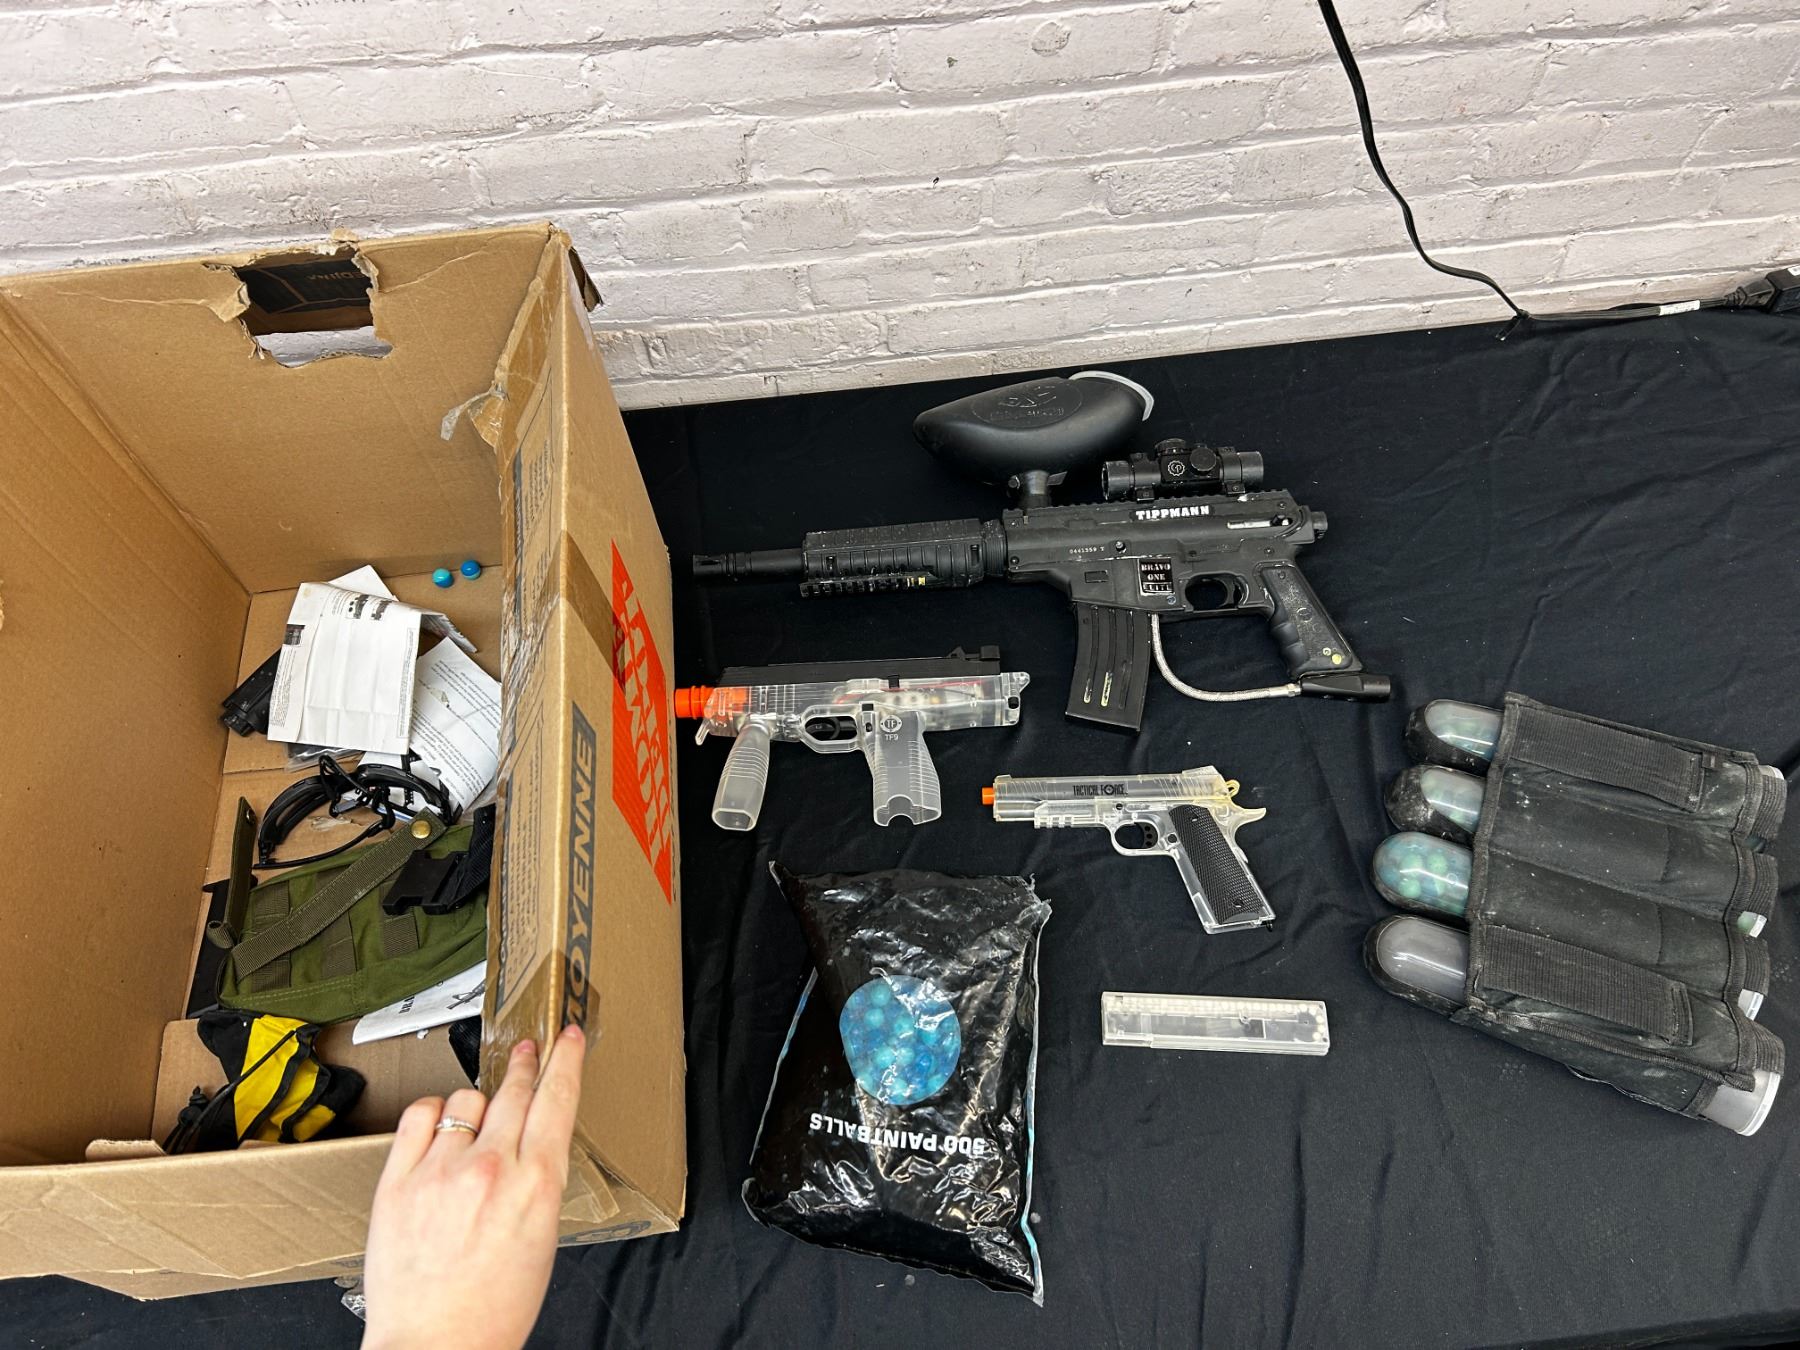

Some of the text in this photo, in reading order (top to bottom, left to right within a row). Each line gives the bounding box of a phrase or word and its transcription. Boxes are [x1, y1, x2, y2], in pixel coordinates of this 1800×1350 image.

[1135, 505, 1210, 520] TIPPMANN
[1141, 563, 1171, 571] BRAVO
[1147, 573, 1166, 581] ONE
[884, 733, 899, 741] TF9
[1072, 784, 1125, 796] TACTICAL FORCE
[809, 1113, 986, 1155] 500 PAINTBALLS
